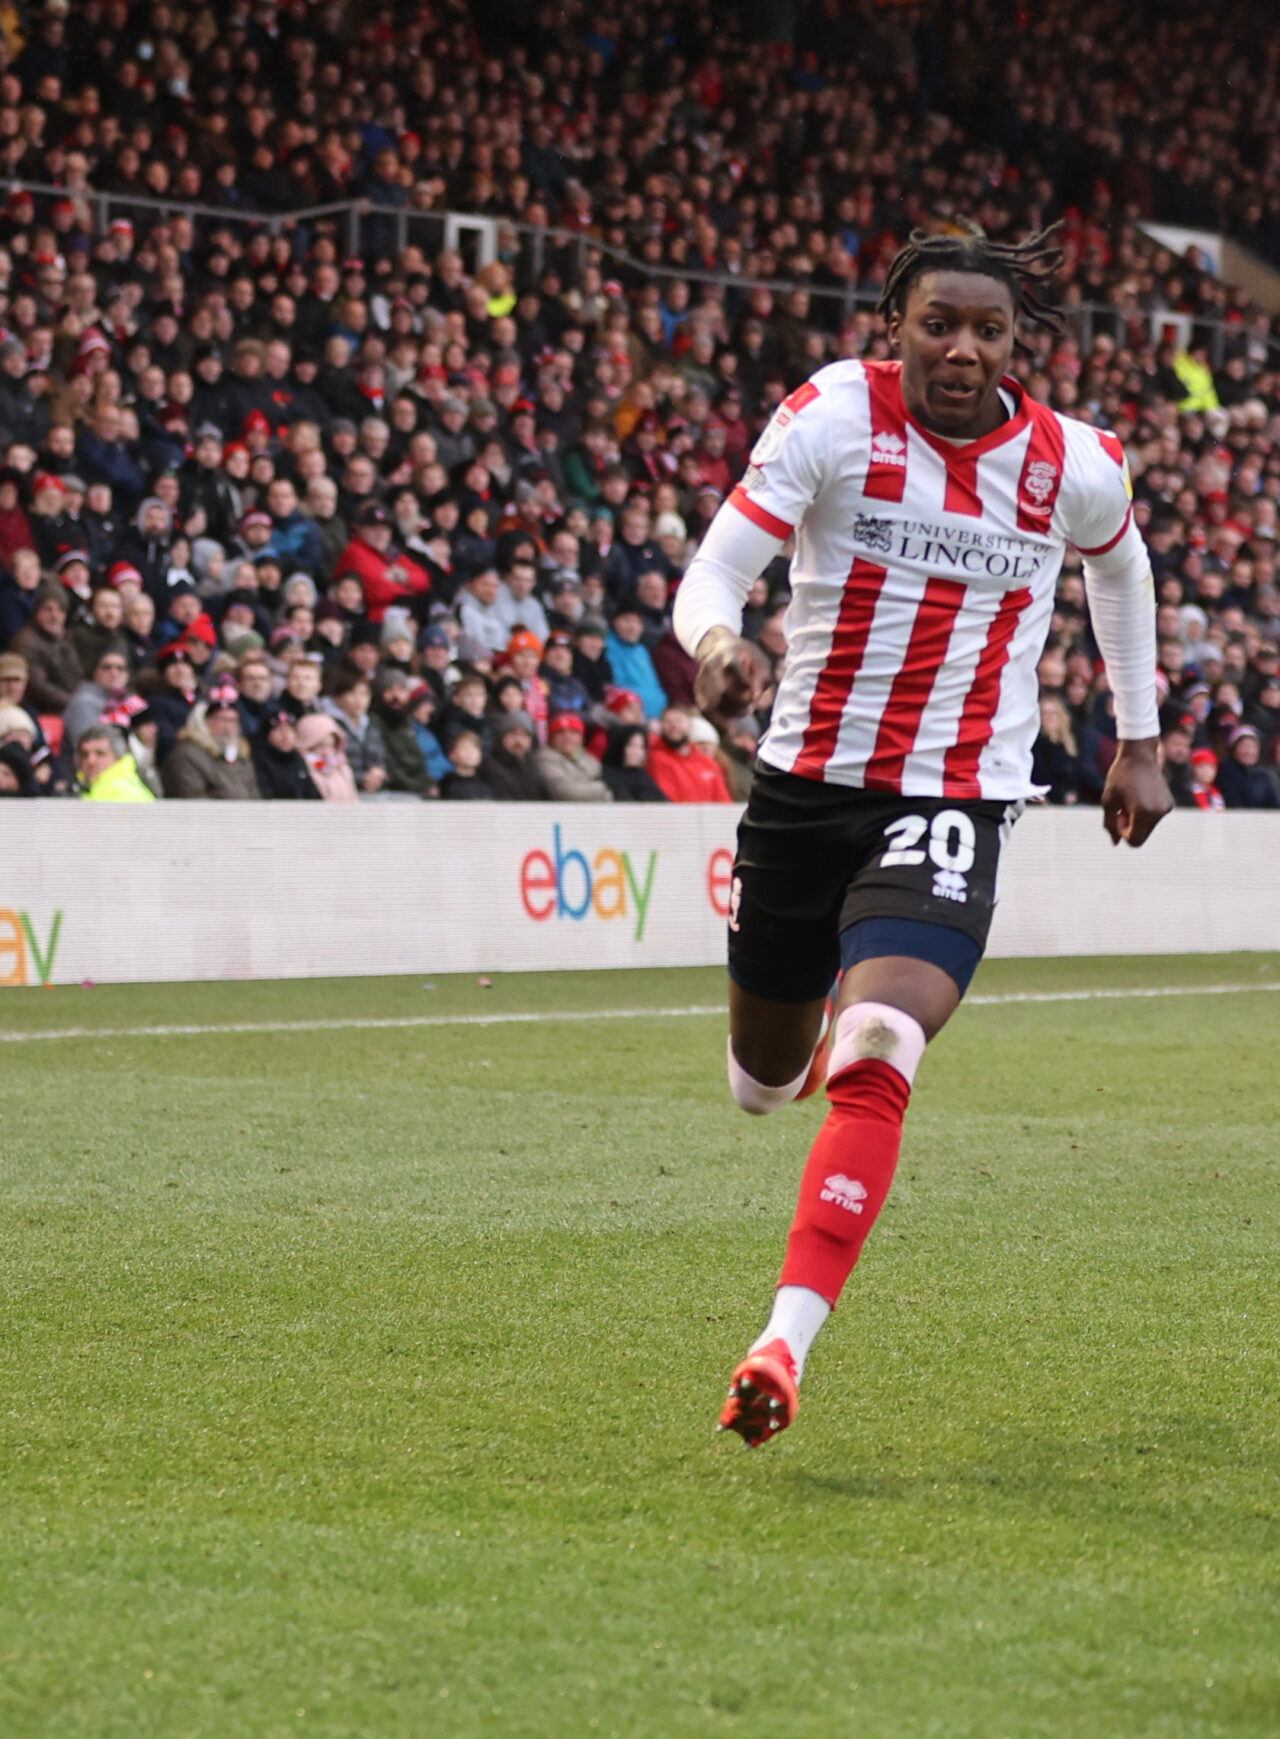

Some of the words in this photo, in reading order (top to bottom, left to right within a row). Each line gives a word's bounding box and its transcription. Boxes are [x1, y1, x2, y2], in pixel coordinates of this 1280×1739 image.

[903, 520, 1029, 553] UNIVERSITY
[880, 809, 976, 873] 20
[520, 823, 658, 942] ebay
